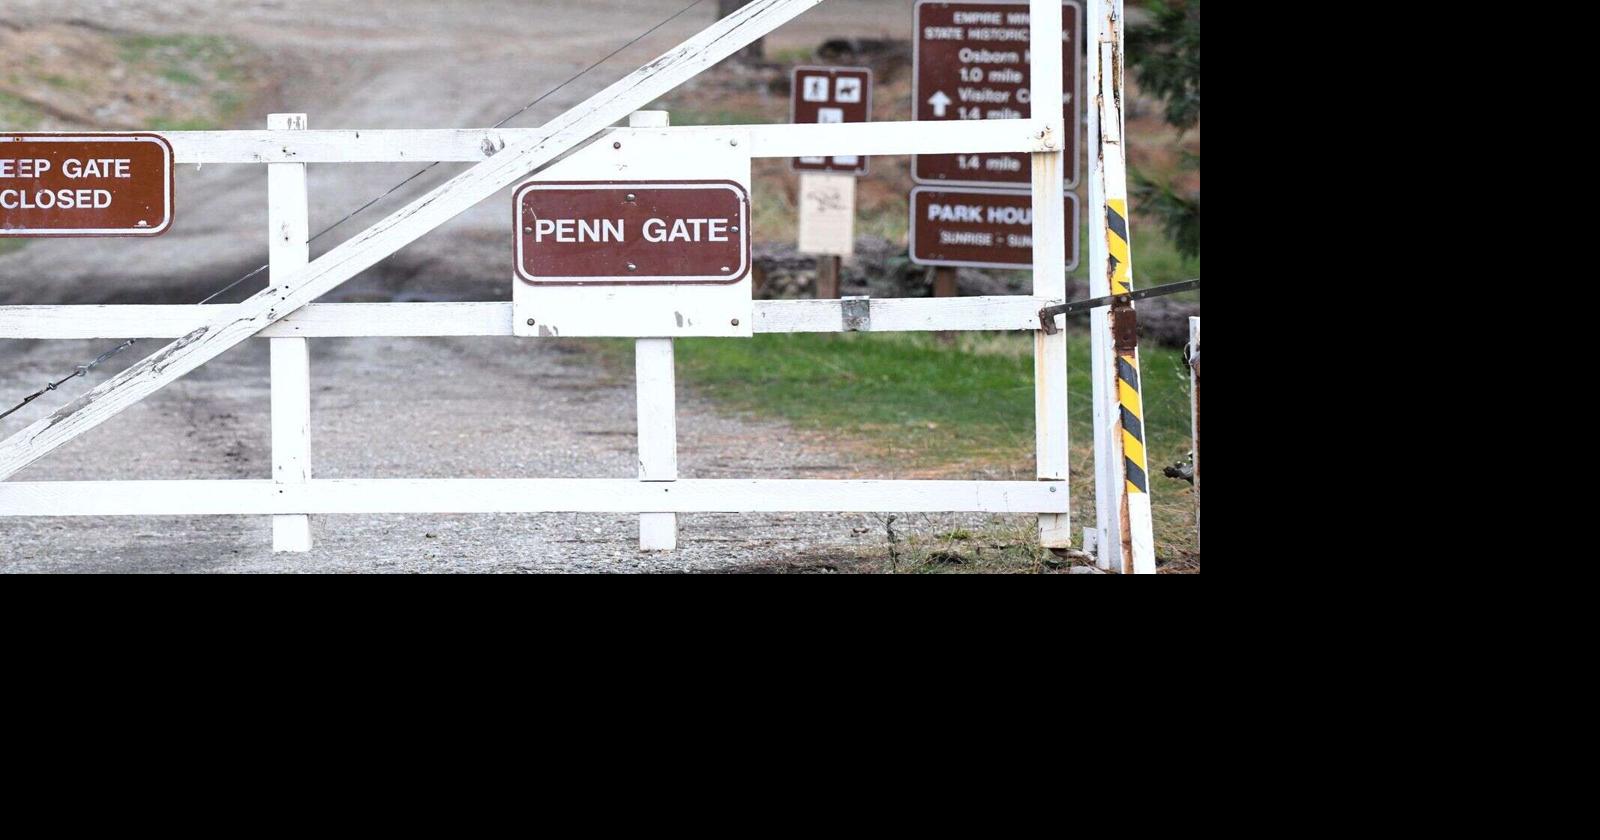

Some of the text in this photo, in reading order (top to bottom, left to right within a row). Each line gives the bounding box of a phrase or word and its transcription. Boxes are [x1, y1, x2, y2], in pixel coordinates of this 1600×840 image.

[1007, 12, 1030, 25] MIN
[924, 26, 965, 40] STATE
[958, 48, 1019, 63] Osborn
[959, 67, 1023, 83] 1.0 mile
[958, 88, 1010, 103] Visitor
[986, 107, 1022, 119] mile
[0, 158, 131, 179] EEP GATE
[957, 155, 1021, 171] 1.4 mile
[0, 189, 112, 209] CLOSED
[928, 204, 1032, 225] PARK HOU
[535, 217, 728, 243] PENN GATE
